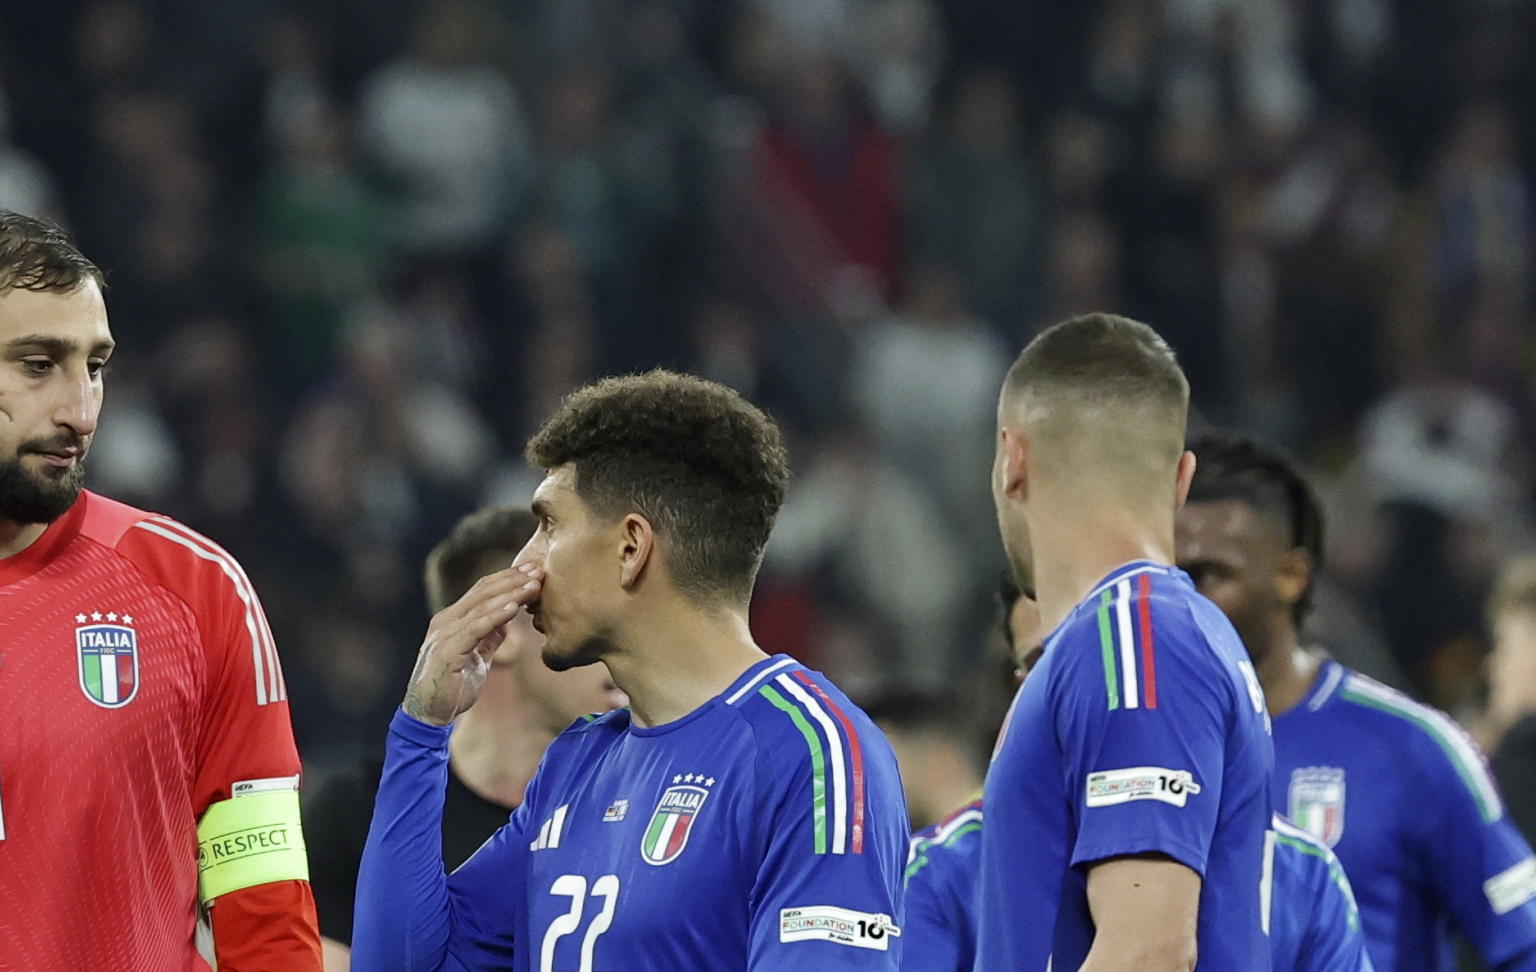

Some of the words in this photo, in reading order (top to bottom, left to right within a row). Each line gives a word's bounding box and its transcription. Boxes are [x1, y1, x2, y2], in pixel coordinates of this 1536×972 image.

[80, 631, 132, 648] ITALIA
[234, 783, 254, 792] UEFA
[662, 791, 701, 808] ITALIA
[211, 829, 288, 860] RESPECT
[783, 919, 855, 934] FOUNDATION
[857, 919, 886, 941] 10
